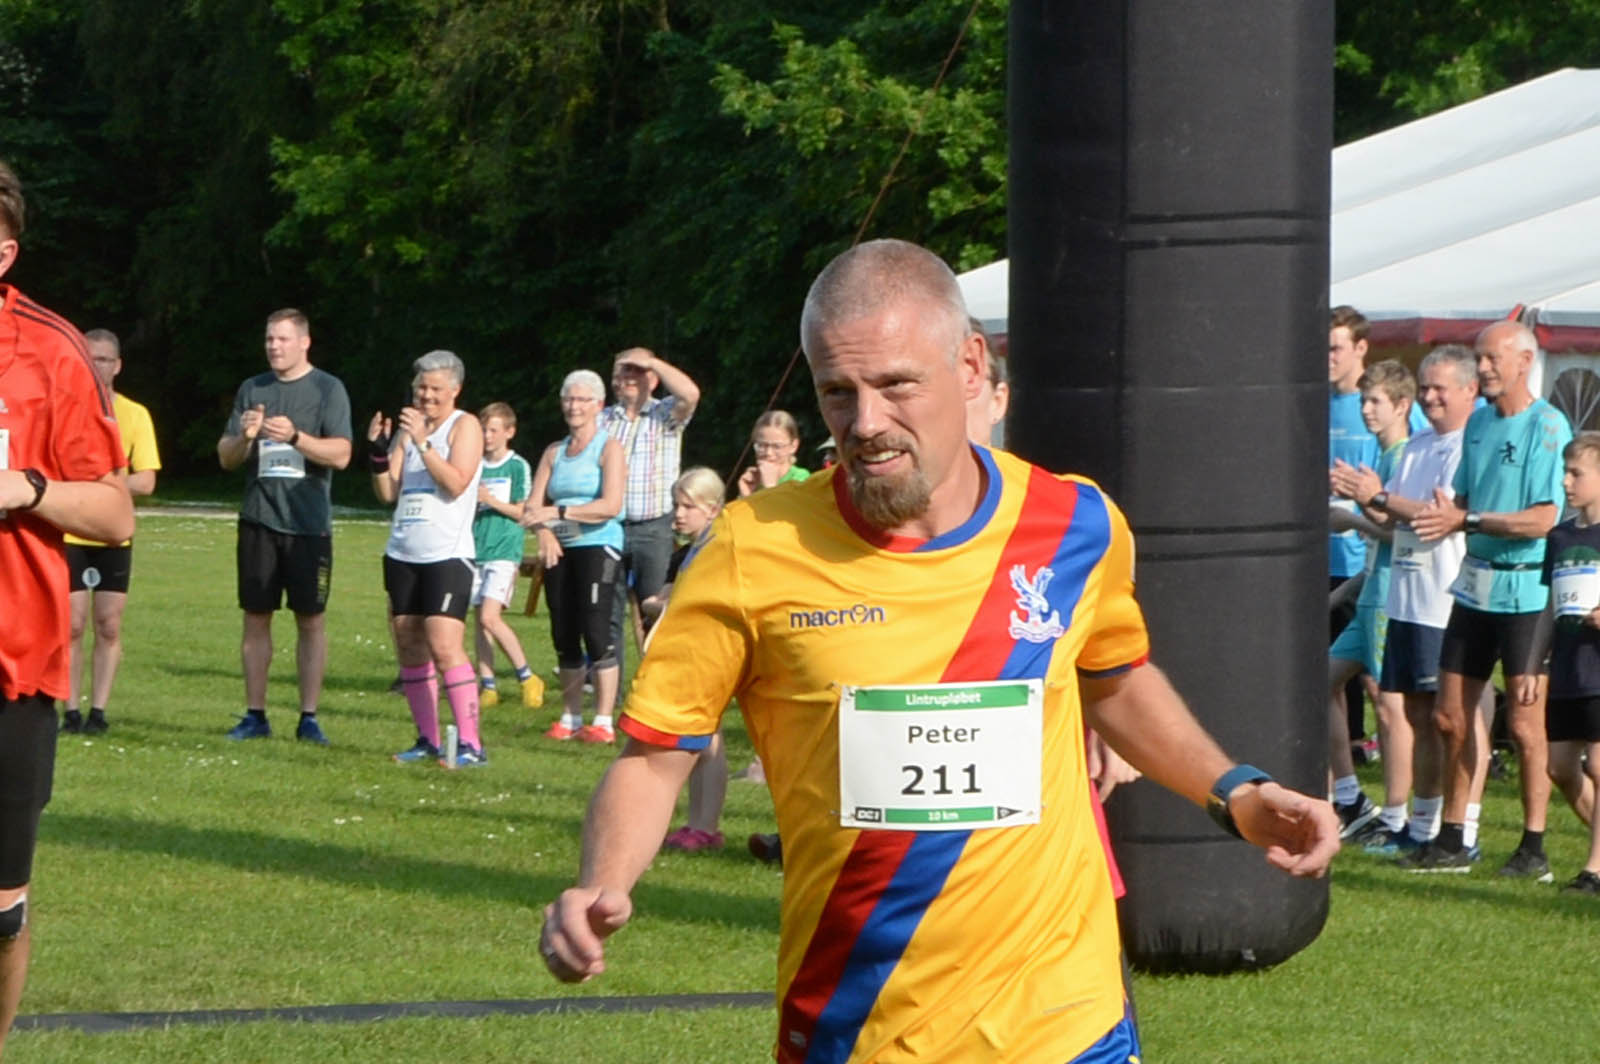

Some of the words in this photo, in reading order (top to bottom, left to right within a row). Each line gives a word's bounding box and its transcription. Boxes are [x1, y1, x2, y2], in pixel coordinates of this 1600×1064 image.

[789, 603, 885, 629] macron
[907, 724, 982, 745] Peter
[900, 763, 983, 796] 211
